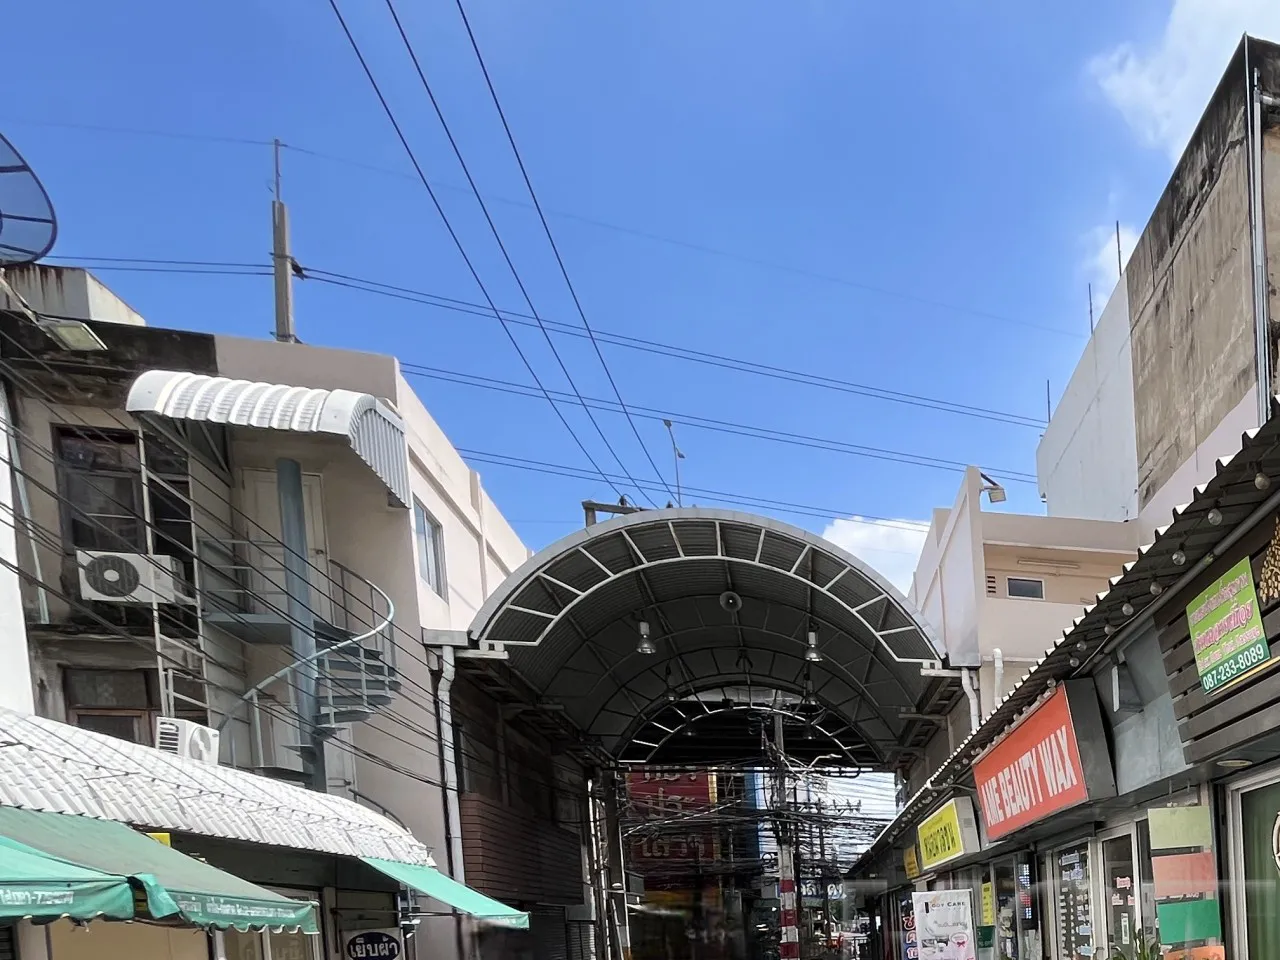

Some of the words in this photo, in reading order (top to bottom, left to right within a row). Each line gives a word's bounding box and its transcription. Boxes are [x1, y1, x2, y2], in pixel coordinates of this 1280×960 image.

[1203, 643, 1265, 691] 087-233-8089
[998, 747, 1043, 819] BEAUTY
[1037, 725, 1077, 797] WAX
